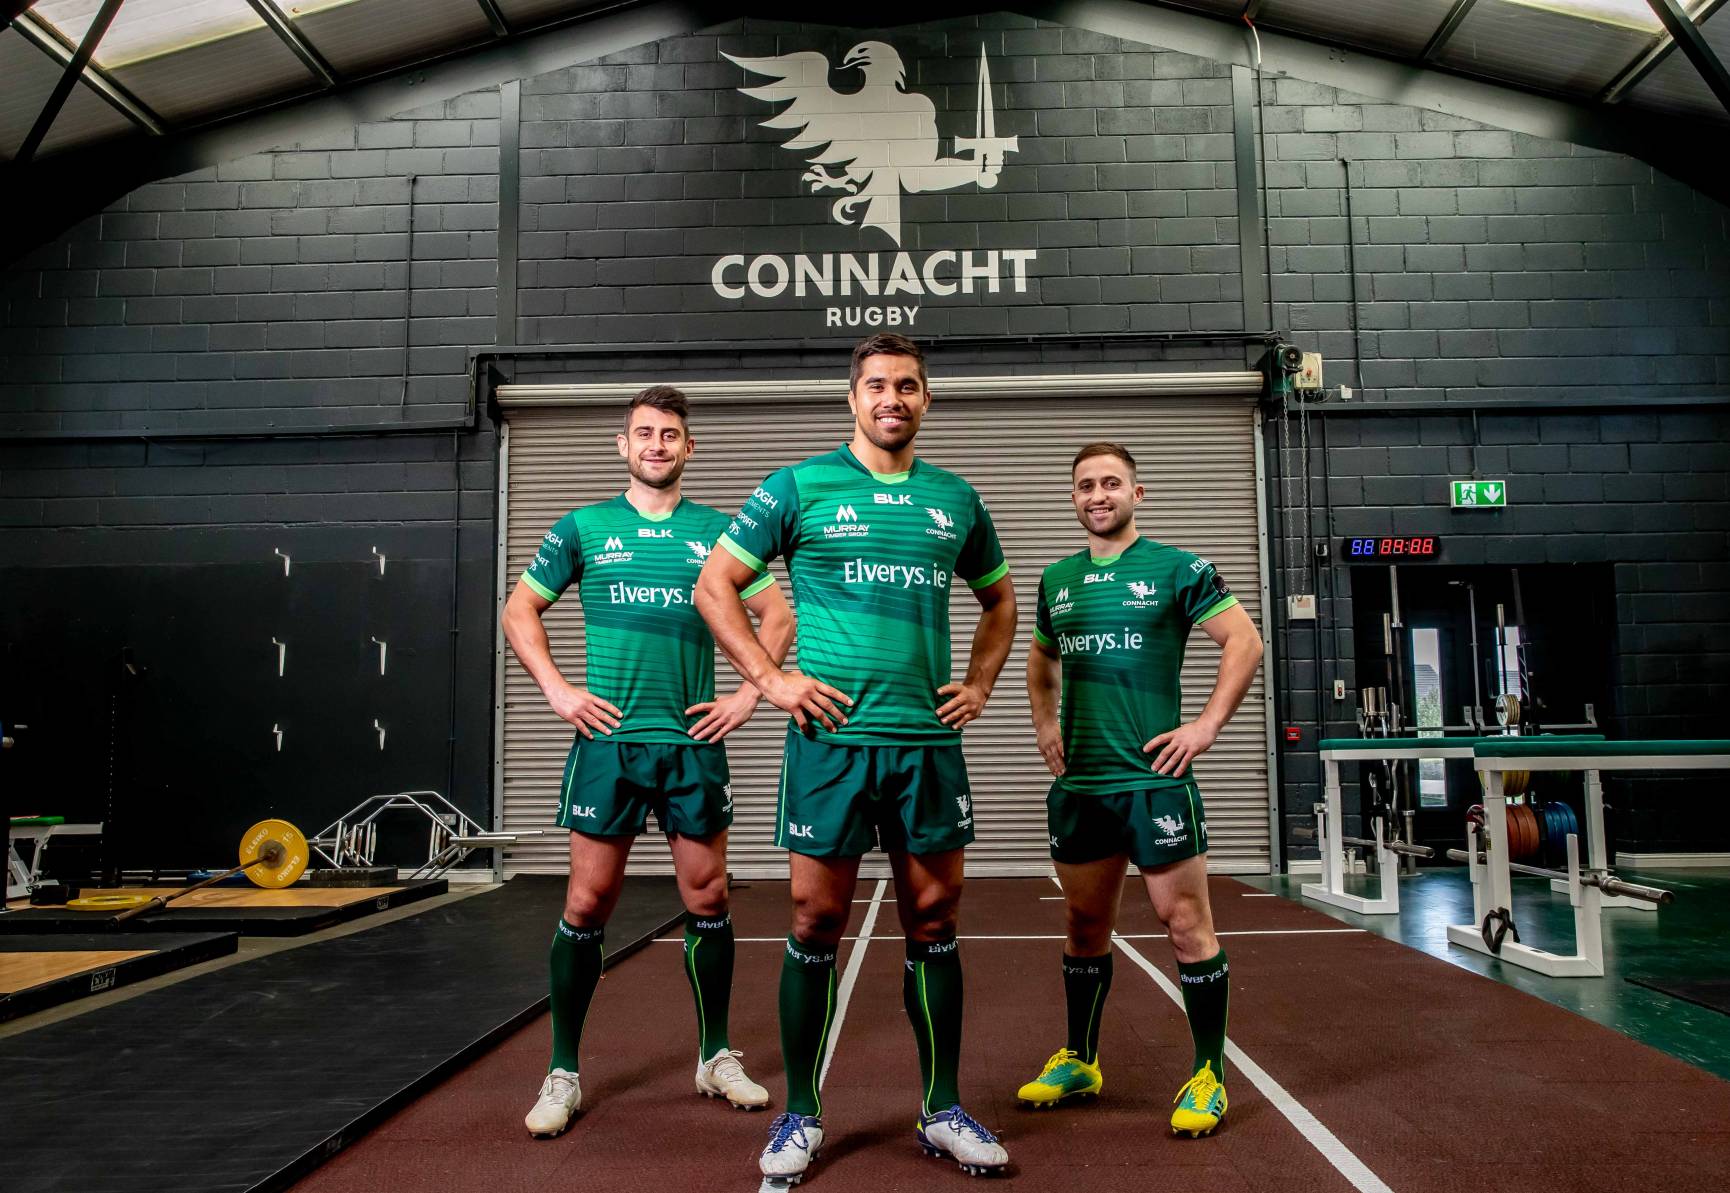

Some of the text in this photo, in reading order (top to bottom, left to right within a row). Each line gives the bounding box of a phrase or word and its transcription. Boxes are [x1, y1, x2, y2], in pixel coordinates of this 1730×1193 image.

[711, 249, 1037, 299] CONNACHT
[826, 305, 919, 327] RUGBY
[873, 493, 914, 505] BLK
[638, 528, 674, 538] BLK
[823, 524, 870, 534] MURRAY
[925, 528, 957, 540] CONNACHT
[594, 551, 634, 562] MURRAY
[844, 557, 947, 589] Elverys.ie
[1083, 572, 1116, 584] BLK
[609, 581, 696, 608] Elverys.i
[1058, 626, 1143, 655] Elverys.ie
[572, 804, 597, 819] BLK
[789, 822, 814, 839] BLK
[245, 828, 269, 855] ELEIKO
[1154, 834, 1188, 845] CONNACHT
